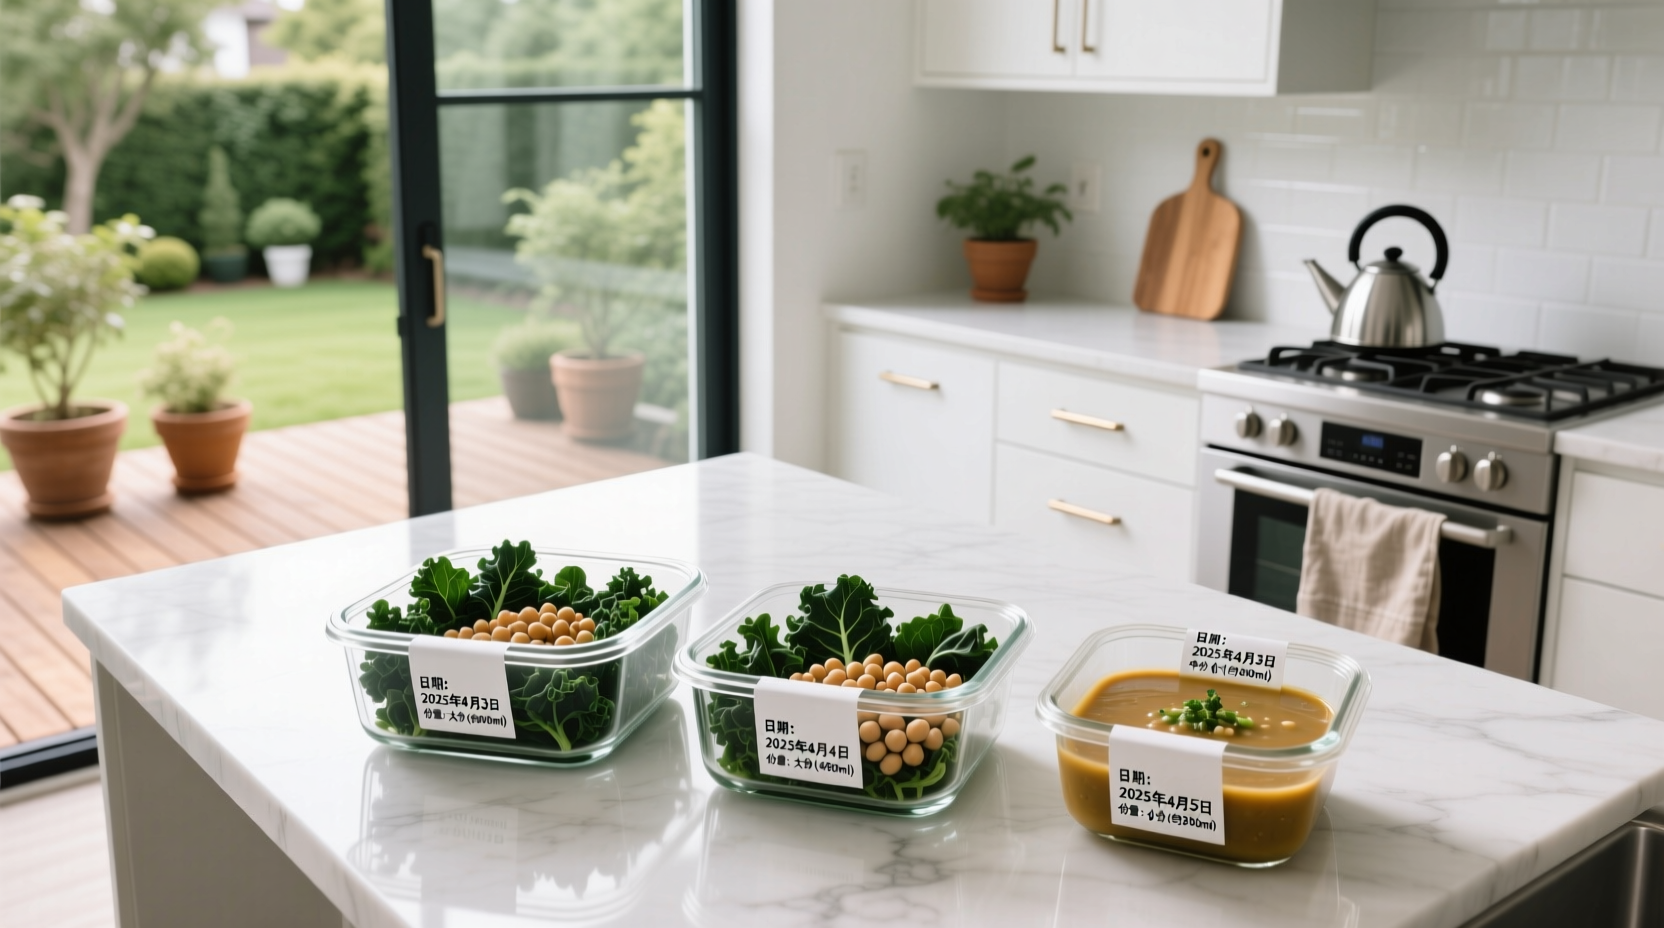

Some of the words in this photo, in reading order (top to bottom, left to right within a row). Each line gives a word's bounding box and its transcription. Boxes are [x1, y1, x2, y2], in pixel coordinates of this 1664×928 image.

[421, 693, 499, 711] 2025年4月3日
[766, 737, 848, 759] 2025年4月4日
[1119, 787, 1211, 816] 2025年4月5日
